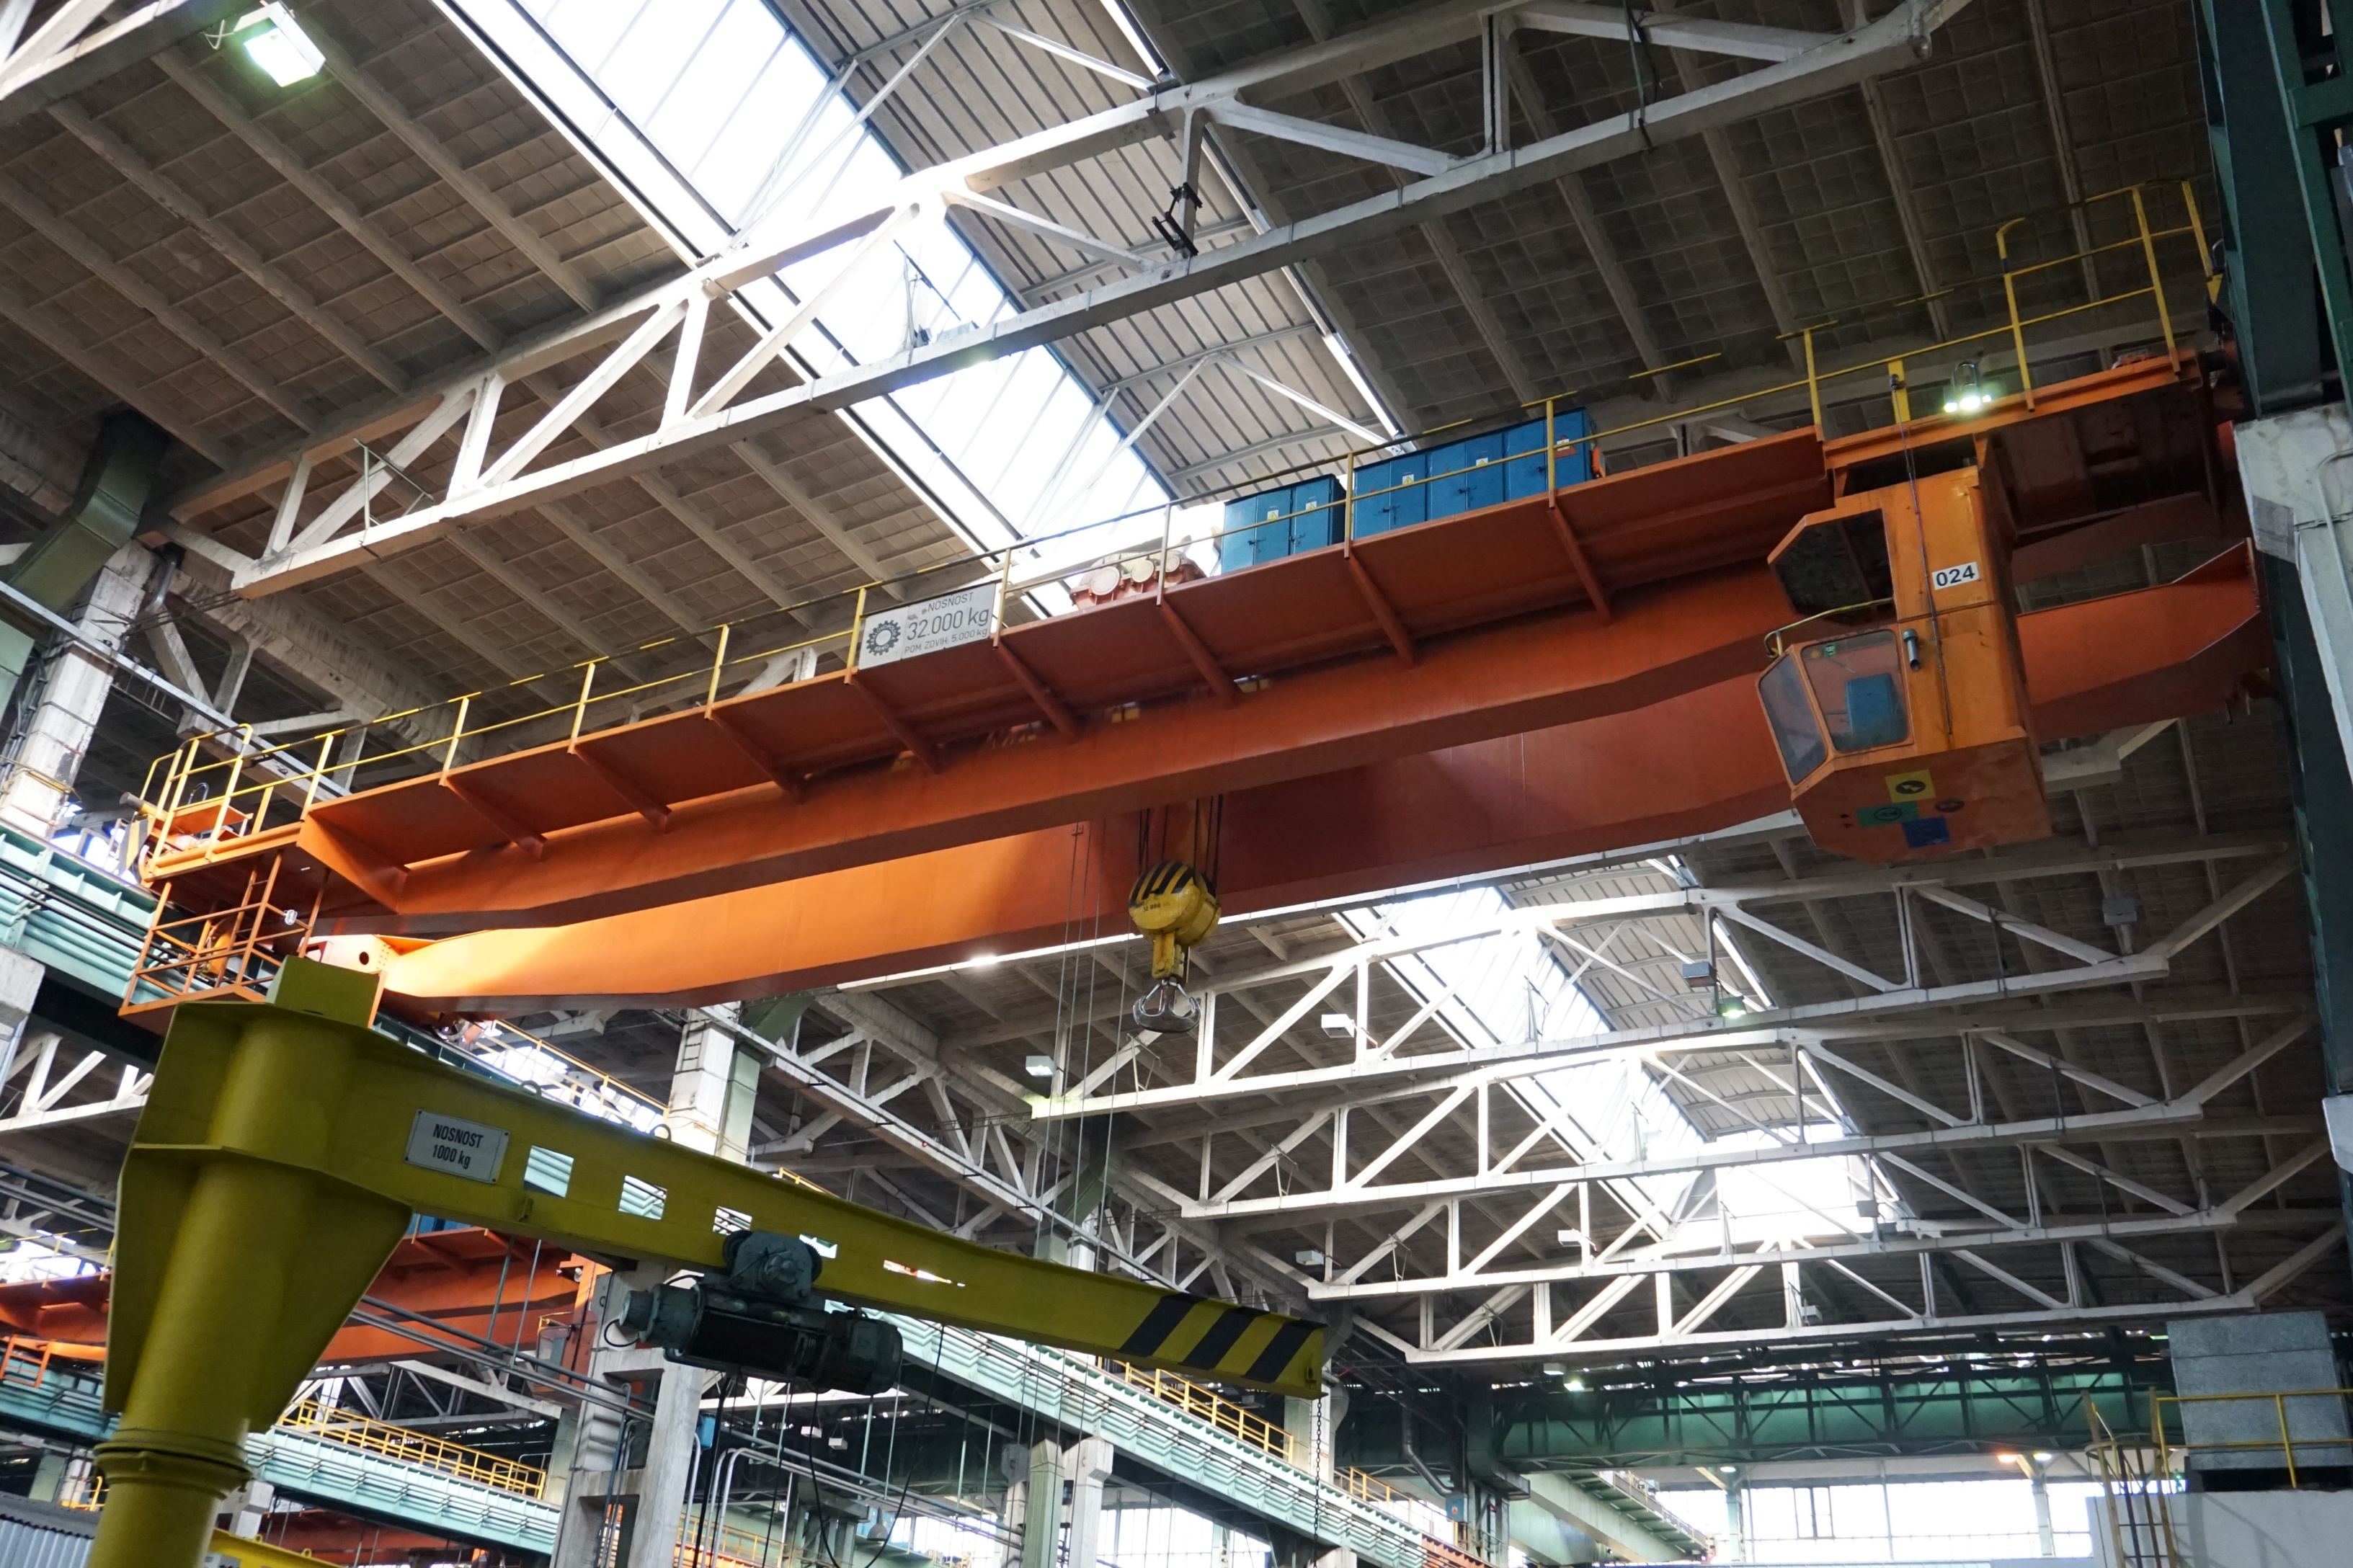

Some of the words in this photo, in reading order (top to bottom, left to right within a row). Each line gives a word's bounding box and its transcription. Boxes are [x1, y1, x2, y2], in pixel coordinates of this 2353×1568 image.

[1936, 565, 1975, 587] 024
[928, 592, 974, 612] NOSNOST
[907, 610, 964, 641] 32.000
[967, 607, 989, 626] kg
[904, 644, 922, 654] POM.
[951, 632, 975, 642] 5.000
[976, 628, 988, 638] kg
[432, 1123, 484, 1149] NOSNOST
[432, 1144, 457, 1162] 1000
[458, 1150, 471, 1170] kg
